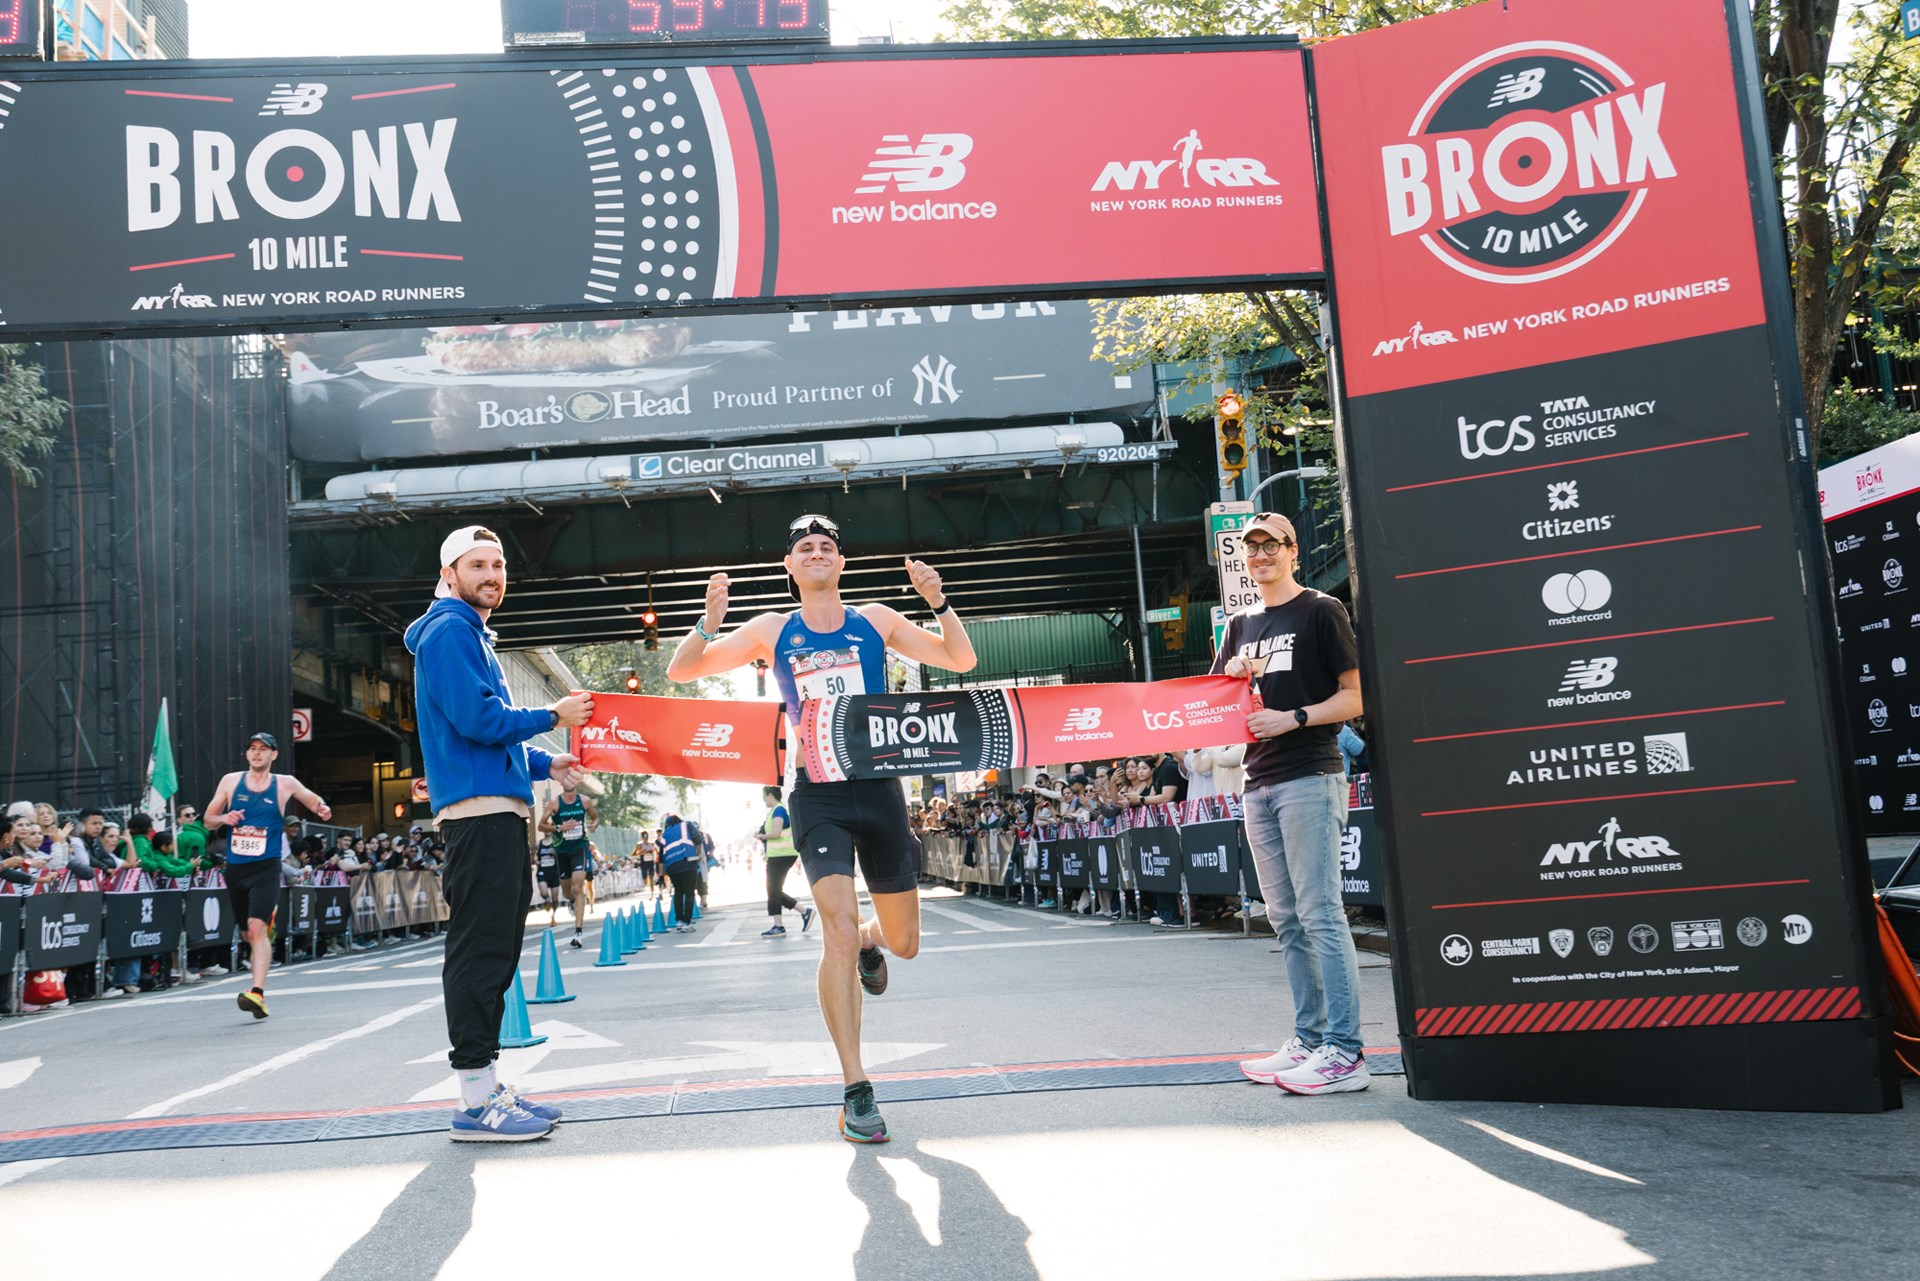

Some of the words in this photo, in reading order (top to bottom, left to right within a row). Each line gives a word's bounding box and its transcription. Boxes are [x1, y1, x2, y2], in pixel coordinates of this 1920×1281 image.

[1487, 67, 1546, 108] NB
[258, 83, 328, 116] NB
[854, 133, 973, 194] NB
[1381, 81, 1677, 236] BRONX
[125, 118, 462, 232] BRONX
[832, 205, 883, 224] new
[890, 199, 997, 222] balance
[1090, 200, 1125, 212] NEW
[1128, 198, 1168, 210] YORK
[1171, 196, 1212, 209] ROAD
[1216, 194, 1283, 207] RUNNERS
[1481, 225, 1513, 254] 10
[1519, 208, 1589, 254] MILE
[248, 238, 278, 271] 10
[285, 236, 348, 269] MILE
[222, 293, 265, 307] NEW
[270, 291, 321, 306] YORK
[325, 289, 377, 304] ROAD
[381, 286, 465, 301] RUNNERS
[1463, 321, 1508, 340] NEW
[1513, 310, 1568, 331] YORK
[1571, 297, 1628, 321] ROAD
[1634, 278, 1730, 308] RUNNERS
[713, 384, 778, 409] Proud
[785, 381, 866, 404] Partner
[871, 378, 893, 398] of
[1541, 395, 1589, 414] TATA
[477, 395, 563, 429] Boar's
[612, 383, 692, 419] Head
[1542, 400, 1656, 431] CONSULTANCY
[1458, 413, 1536, 460] tcs
[1544, 424, 1617, 447] SERVICES
[667, 456, 725, 475] Clear
[729, 448, 817, 472] Channel
[1098, 445, 1158, 463] 920204
[1856, 467, 1883, 491] BRONX
[1522, 516, 1612, 541] Citizens
[1150, 611, 1171, 621] River
[1548, 610, 1612, 626] mastercard
[1860, 622, 1883, 632] UNITED
[826, 676, 845, 695] 50
[1184, 701, 1208, 711] TATA
[1547, 695, 1573, 708] new
[1576, 689, 1632, 705] balance
[1062, 708, 1102, 731] NB
[1143, 709, 1184, 731] tcs
[1186, 704, 1241, 719] CONSULTANCY
[1188, 716, 1223, 727] SERVICES
[690, 723, 734, 747] NB
[868, 711, 959, 748] BRONX
[1055, 734, 1073, 743] new
[1074, 731, 1113, 742] balance
[682, 749, 700, 758] new
[702, 749, 740, 759] balance
[903, 748, 909, 758] 10
[911, 747, 930, 758] MILE
[1529, 741, 1636, 764] UNITED
[1507, 759, 1638, 785] AIRLINES
[240, 841, 260, 851] 5846
[1191, 852, 1218, 867] UNITED
[1540, 871, 1564, 881] NEW
[1566, 869, 1597, 879] YORK
[1598, 866, 1629, 877] ROAD
[1631, 863, 1683, 874] RUNNERS
[130, 930, 162, 948] Citizens
[1481, 939, 1511, 949] CENTRAL
[1512, 938, 1533, 947] PARK
[1482, 946, 1534, 958] CONSERVANCY
[1521, 975, 1567, 983] cooperation
[1585, 972, 1598, 980] the
[1599, 971, 1616, 980] City
[1645, 969, 1666, 977] York,
[1666, 967, 1683, 975] Eric
[1684, 966, 1714, 974] Adams,
[1715, 965, 1740, 973] Mayor
